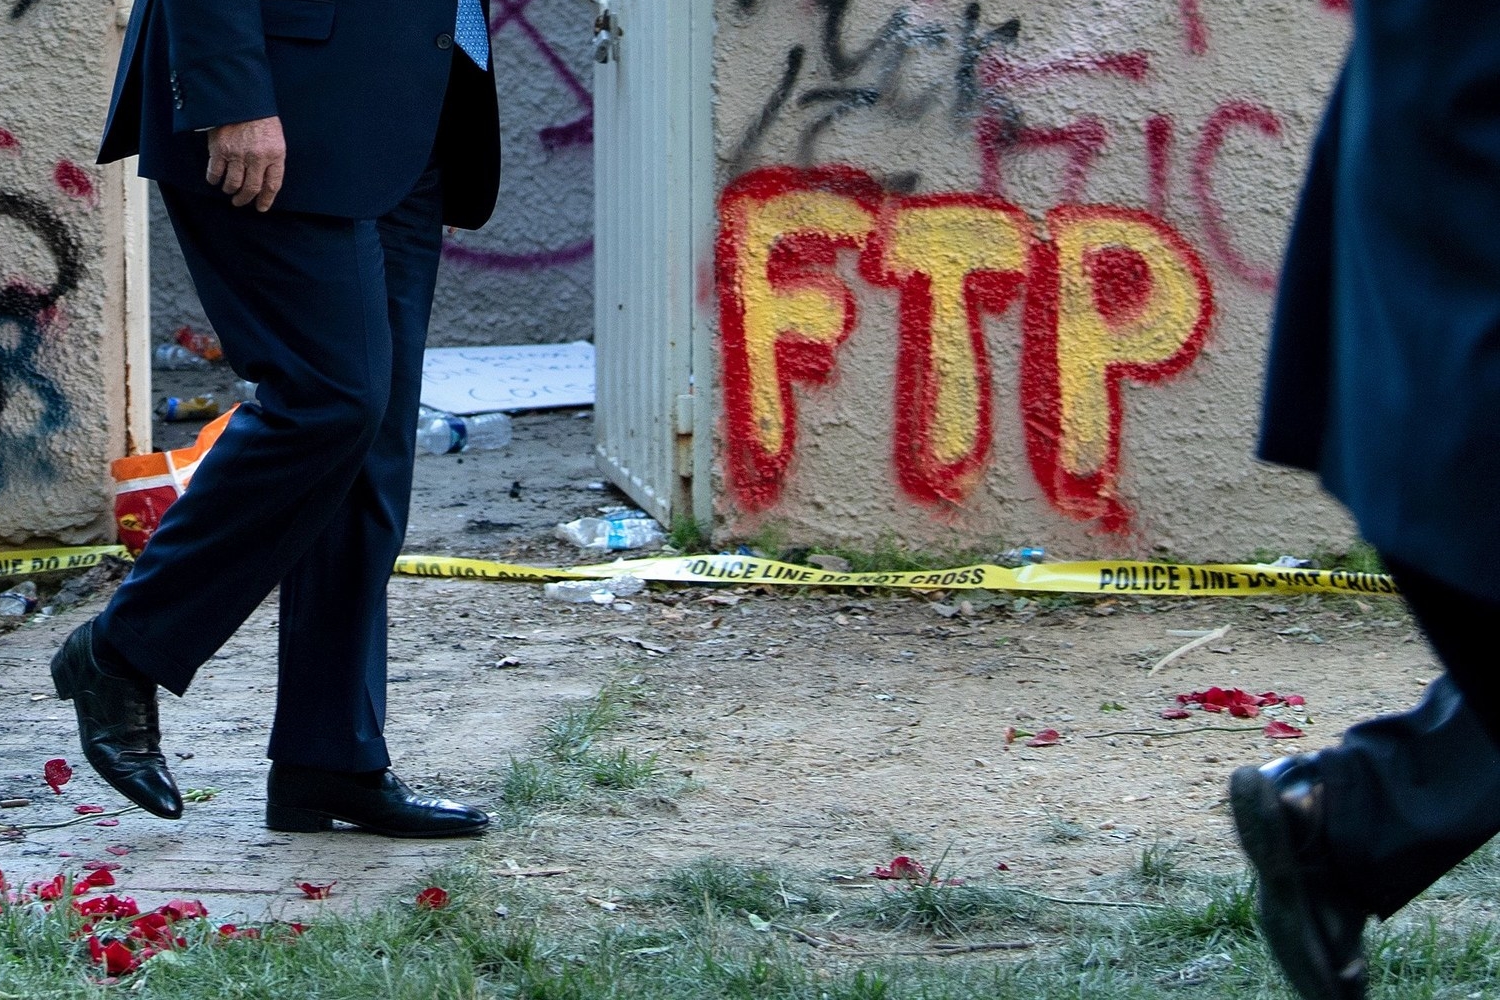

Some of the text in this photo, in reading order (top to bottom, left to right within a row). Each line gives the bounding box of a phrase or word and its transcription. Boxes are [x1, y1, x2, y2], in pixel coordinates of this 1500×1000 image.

[712, 164, 1216, 533] FTP
[31, 556, 60, 571] DO
[677, 557, 986, 586] POLICE LINE DO NOT CROSS
[1100, 565, 1181, 591] POLICE
[1189, 566, 1238, 591] LINE
